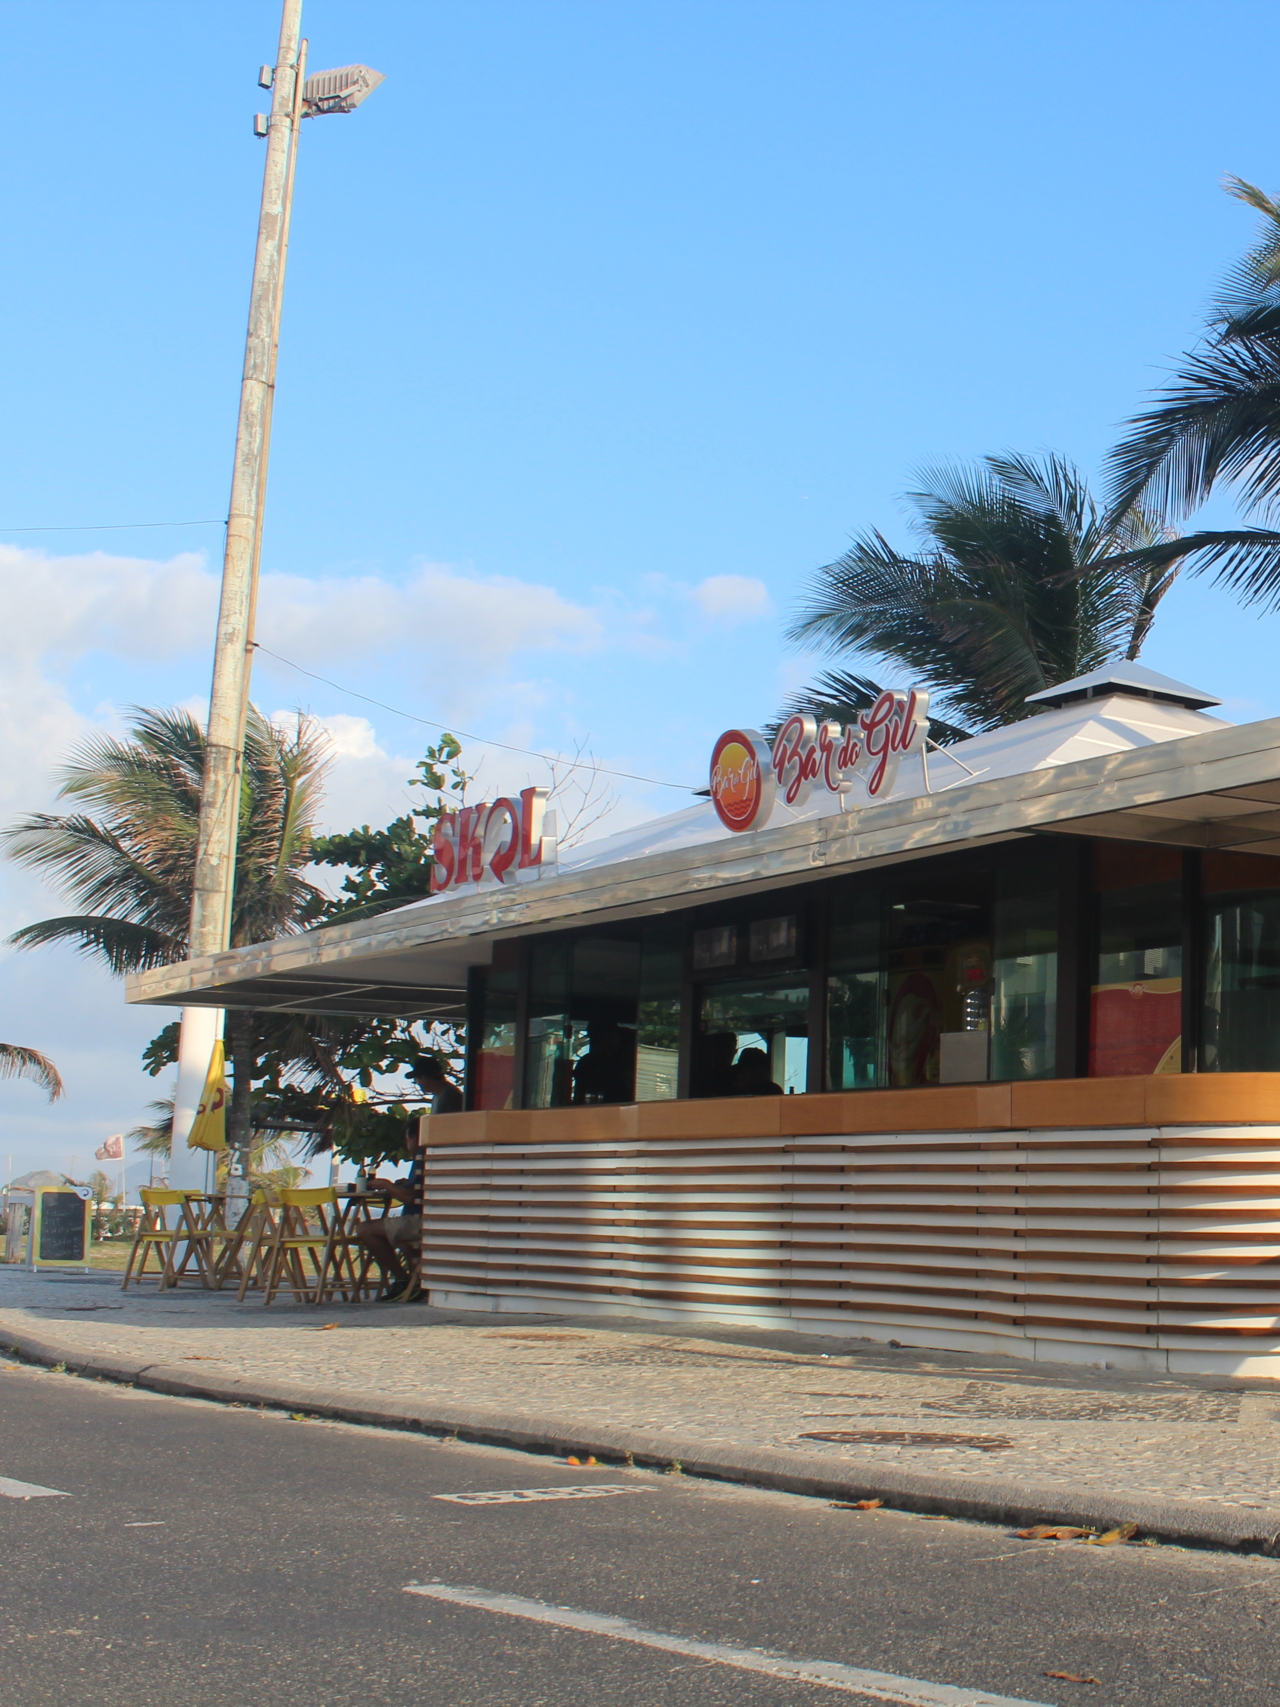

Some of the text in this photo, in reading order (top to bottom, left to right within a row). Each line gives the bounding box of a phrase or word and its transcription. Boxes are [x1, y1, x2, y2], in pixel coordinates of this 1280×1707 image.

[772, 691, 918, 805] Bar do Gil
[430, 786, 542, 893] SKOL
